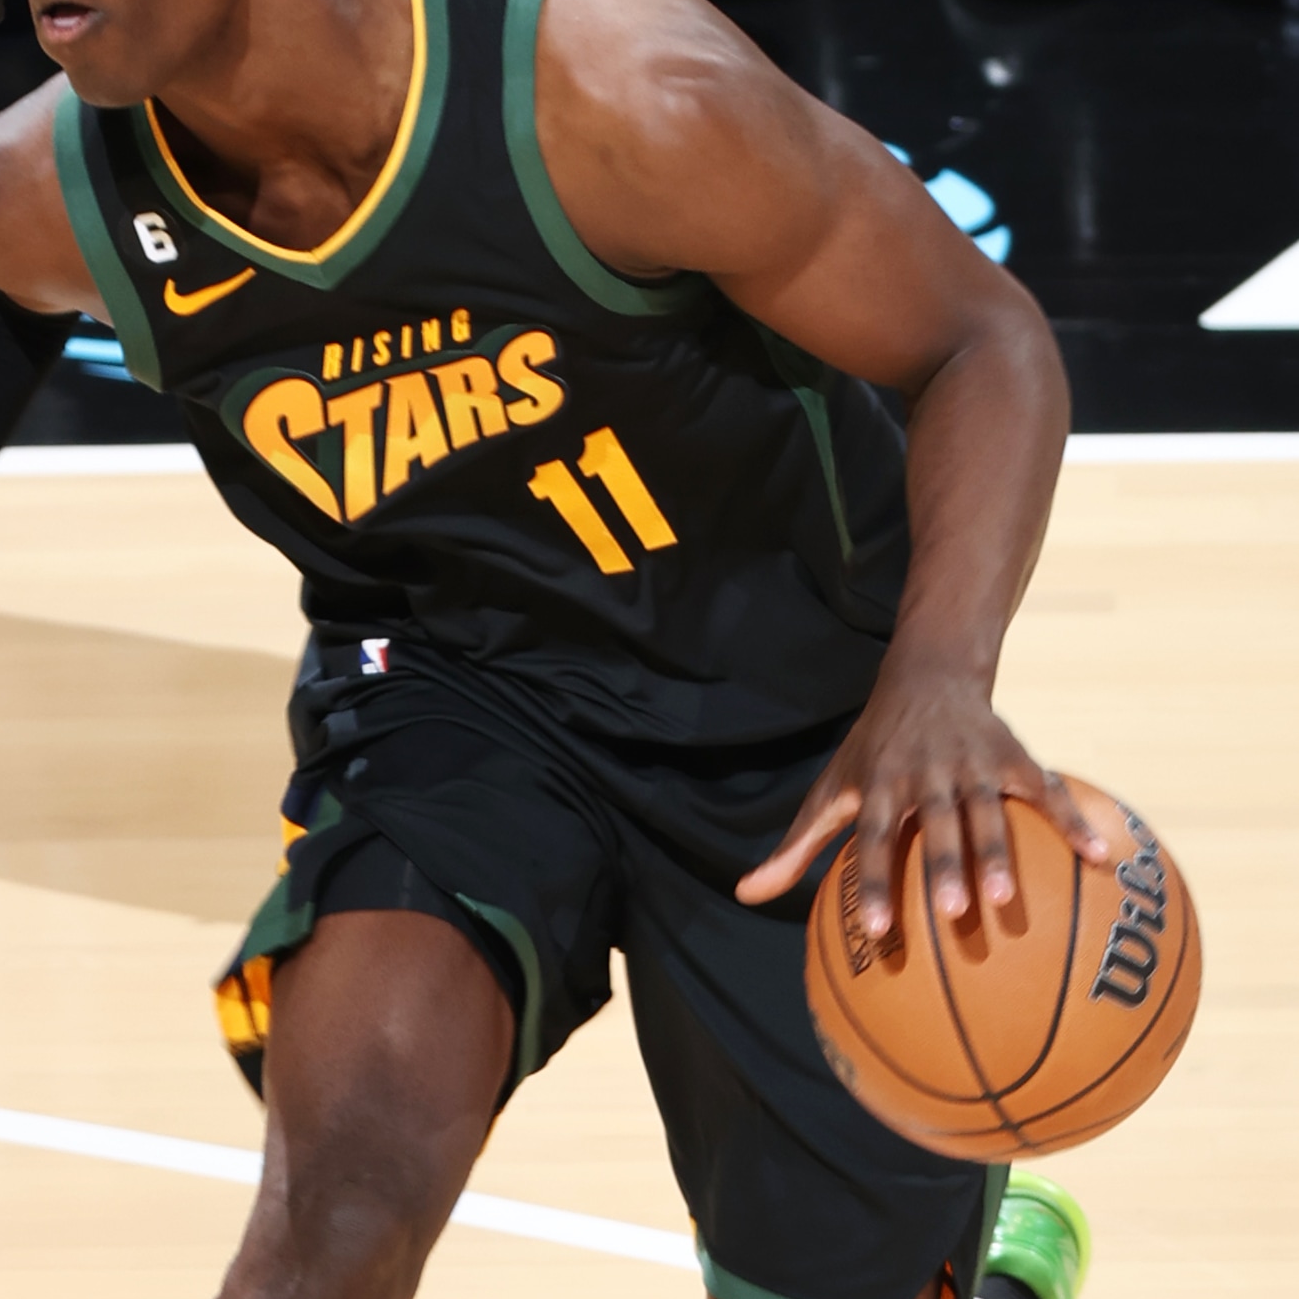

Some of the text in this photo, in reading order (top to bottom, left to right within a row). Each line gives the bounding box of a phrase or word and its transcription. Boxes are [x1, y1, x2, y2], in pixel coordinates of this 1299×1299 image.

[133, 211, 179, 264] 6
[321, 307, 471, 382] RISING
[242, 330, 565, 524] STARS
[527, 426, 678, 574] 11
